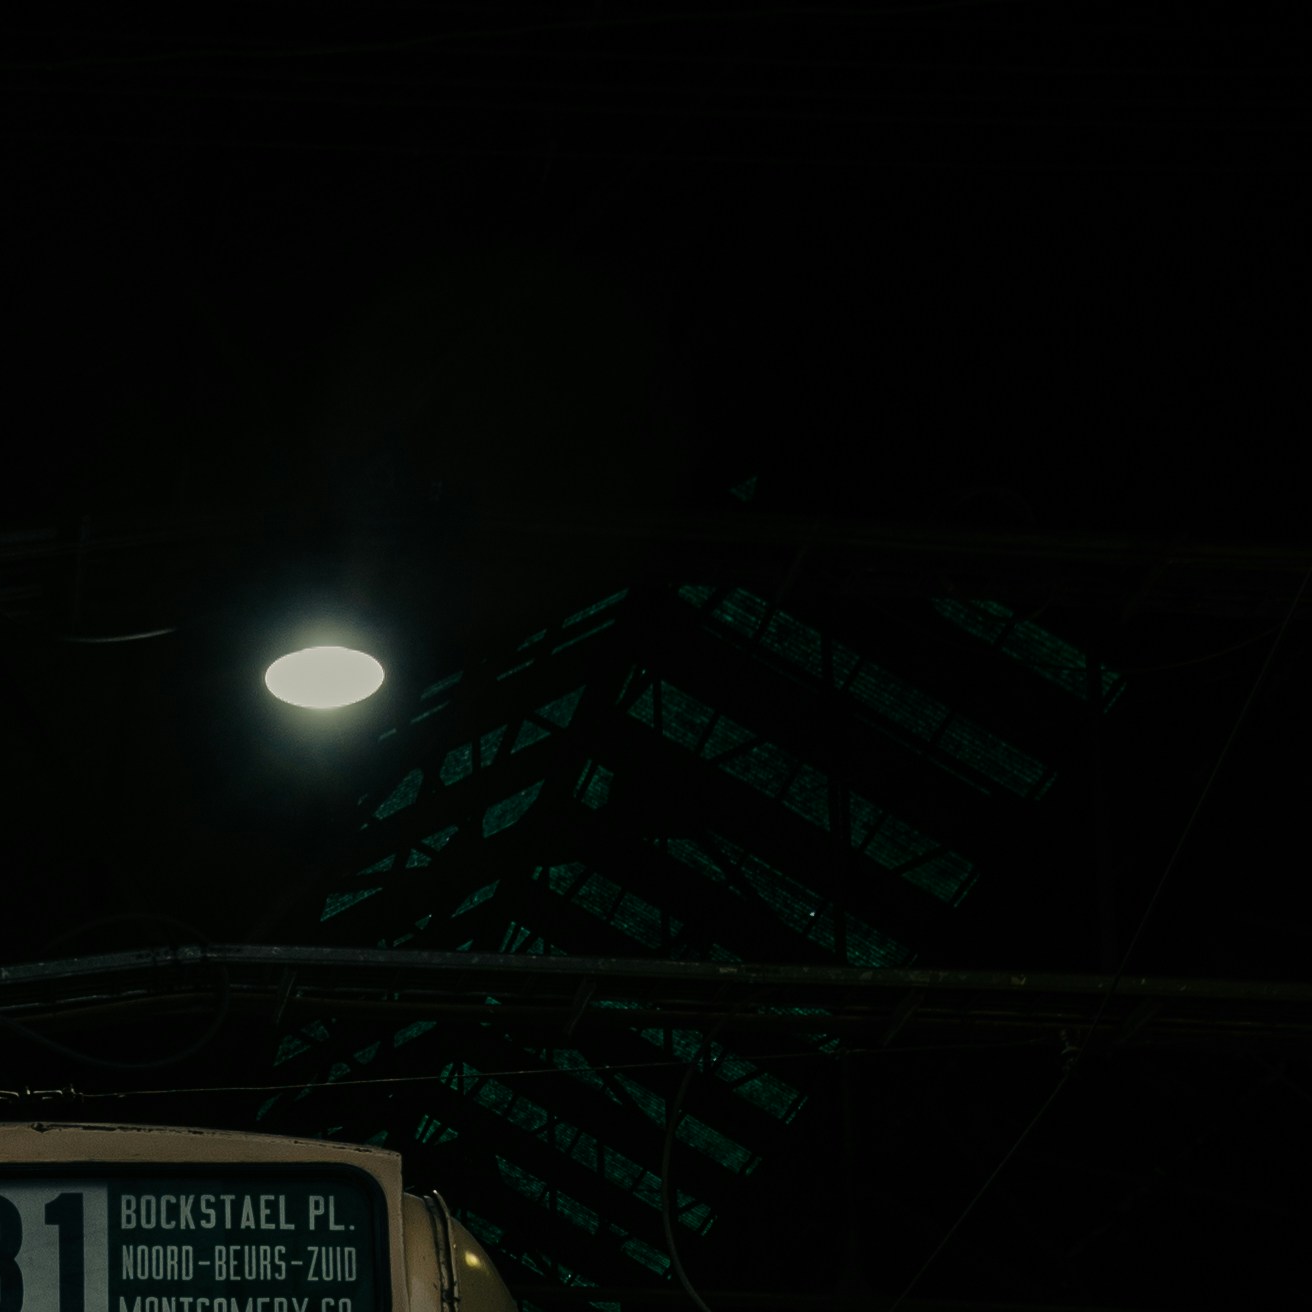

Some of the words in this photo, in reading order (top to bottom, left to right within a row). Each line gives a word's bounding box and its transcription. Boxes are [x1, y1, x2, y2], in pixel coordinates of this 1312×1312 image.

[120, 1193, 296, 1231] BOCKSTAEL
[308, 1194, 356, 1232] PL.
[121, 1244, 358, 1282] NOORD-BEURS-ZUID
